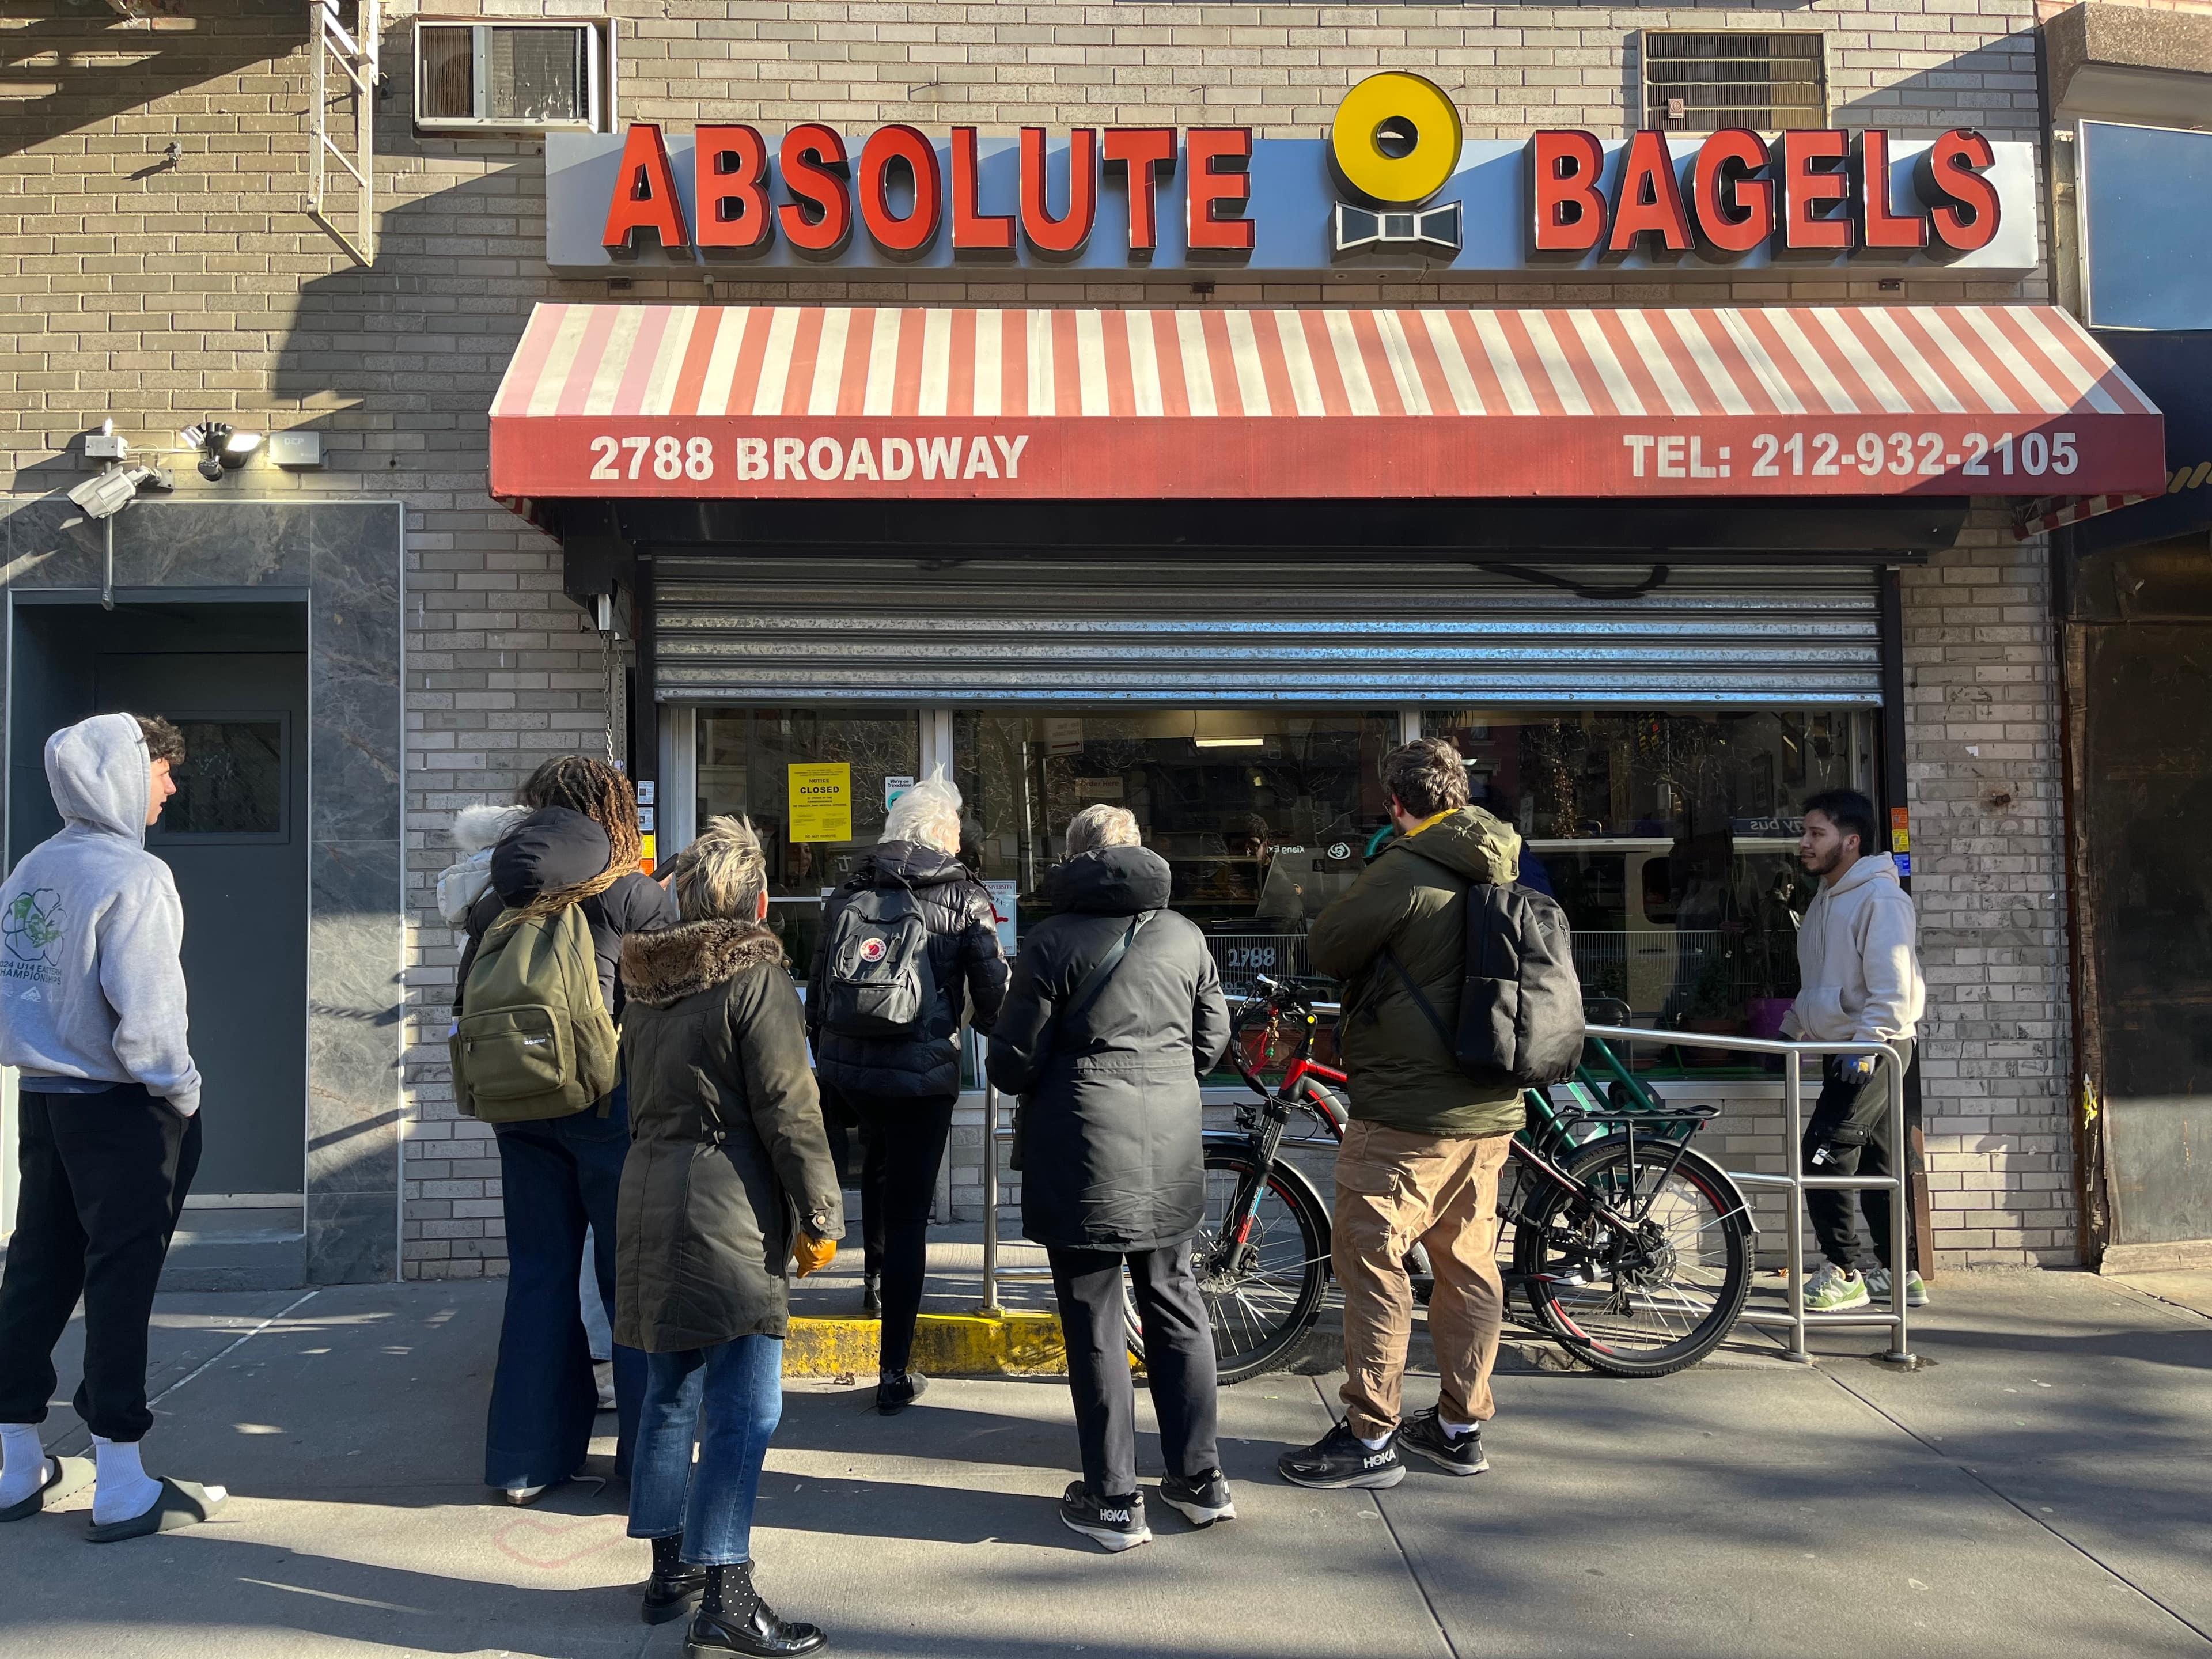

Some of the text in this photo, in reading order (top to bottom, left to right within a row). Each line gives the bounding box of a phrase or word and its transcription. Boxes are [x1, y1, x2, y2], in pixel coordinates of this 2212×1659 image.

[601, 123, 2000, 253] ABSOLUTE BAGELS
[590, 435, 1029, 482] 2788 BROADWAY
[1623, 432, 2079, 478] TEL: 212-932-2105
[1228, 946, 1275, 968] 2788
[0, 968, 62, 985] HAMPIONSHIPS
[17, 962, 35, 971] U14
[37, 965, 62, 976] EASTERN
[1363, 1448, 1396, 1469] HOKA
[1100, 1508, 1130, 1522] HOKA
